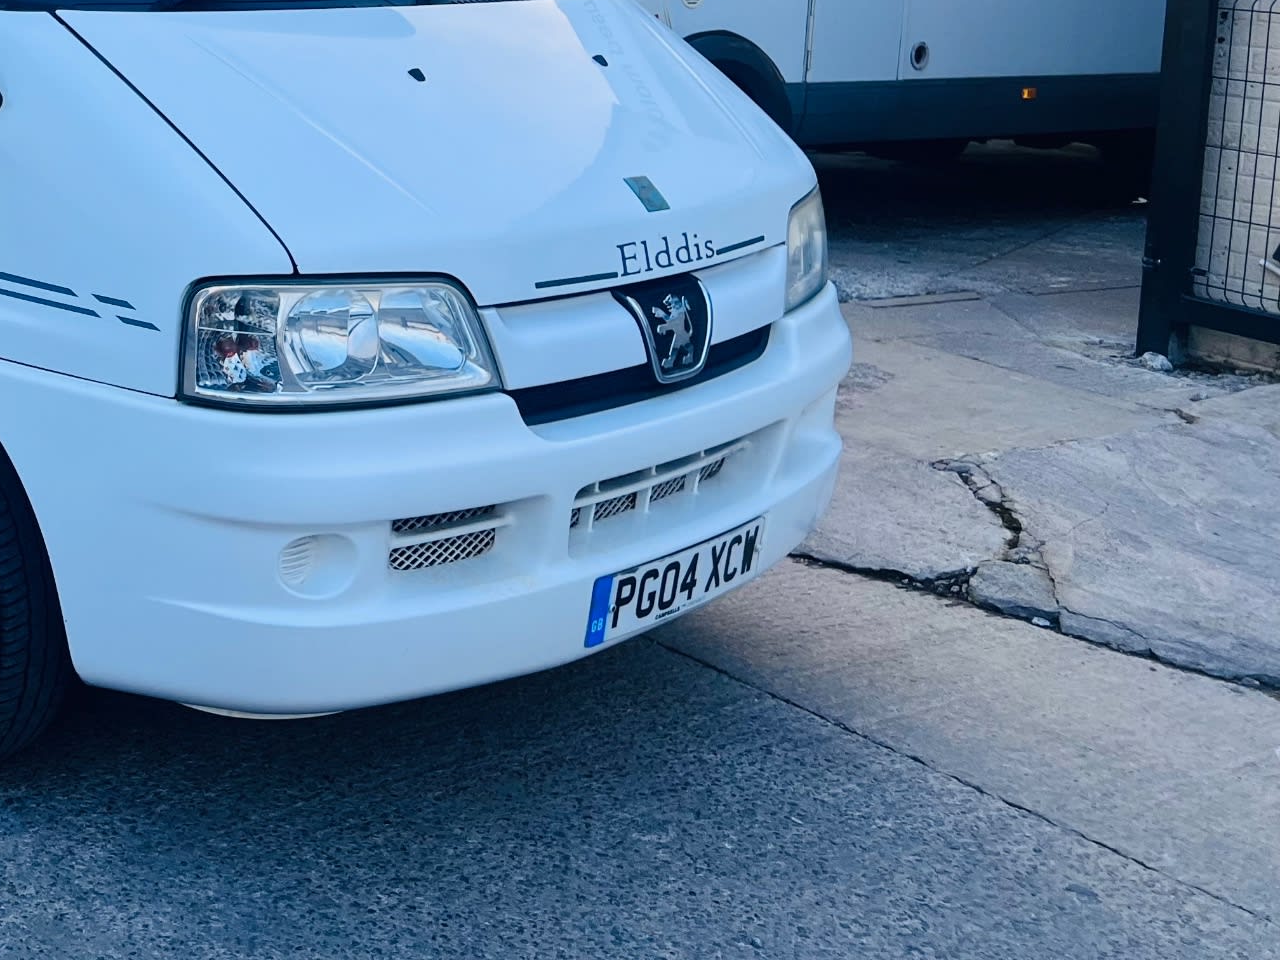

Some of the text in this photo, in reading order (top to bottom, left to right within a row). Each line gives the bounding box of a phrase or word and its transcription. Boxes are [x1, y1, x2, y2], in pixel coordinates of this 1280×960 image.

[616, 232, 715, 277] Elddis
[611, 525, 760, 629] PG04 XCW
[590, 617, 604, 633] GB
